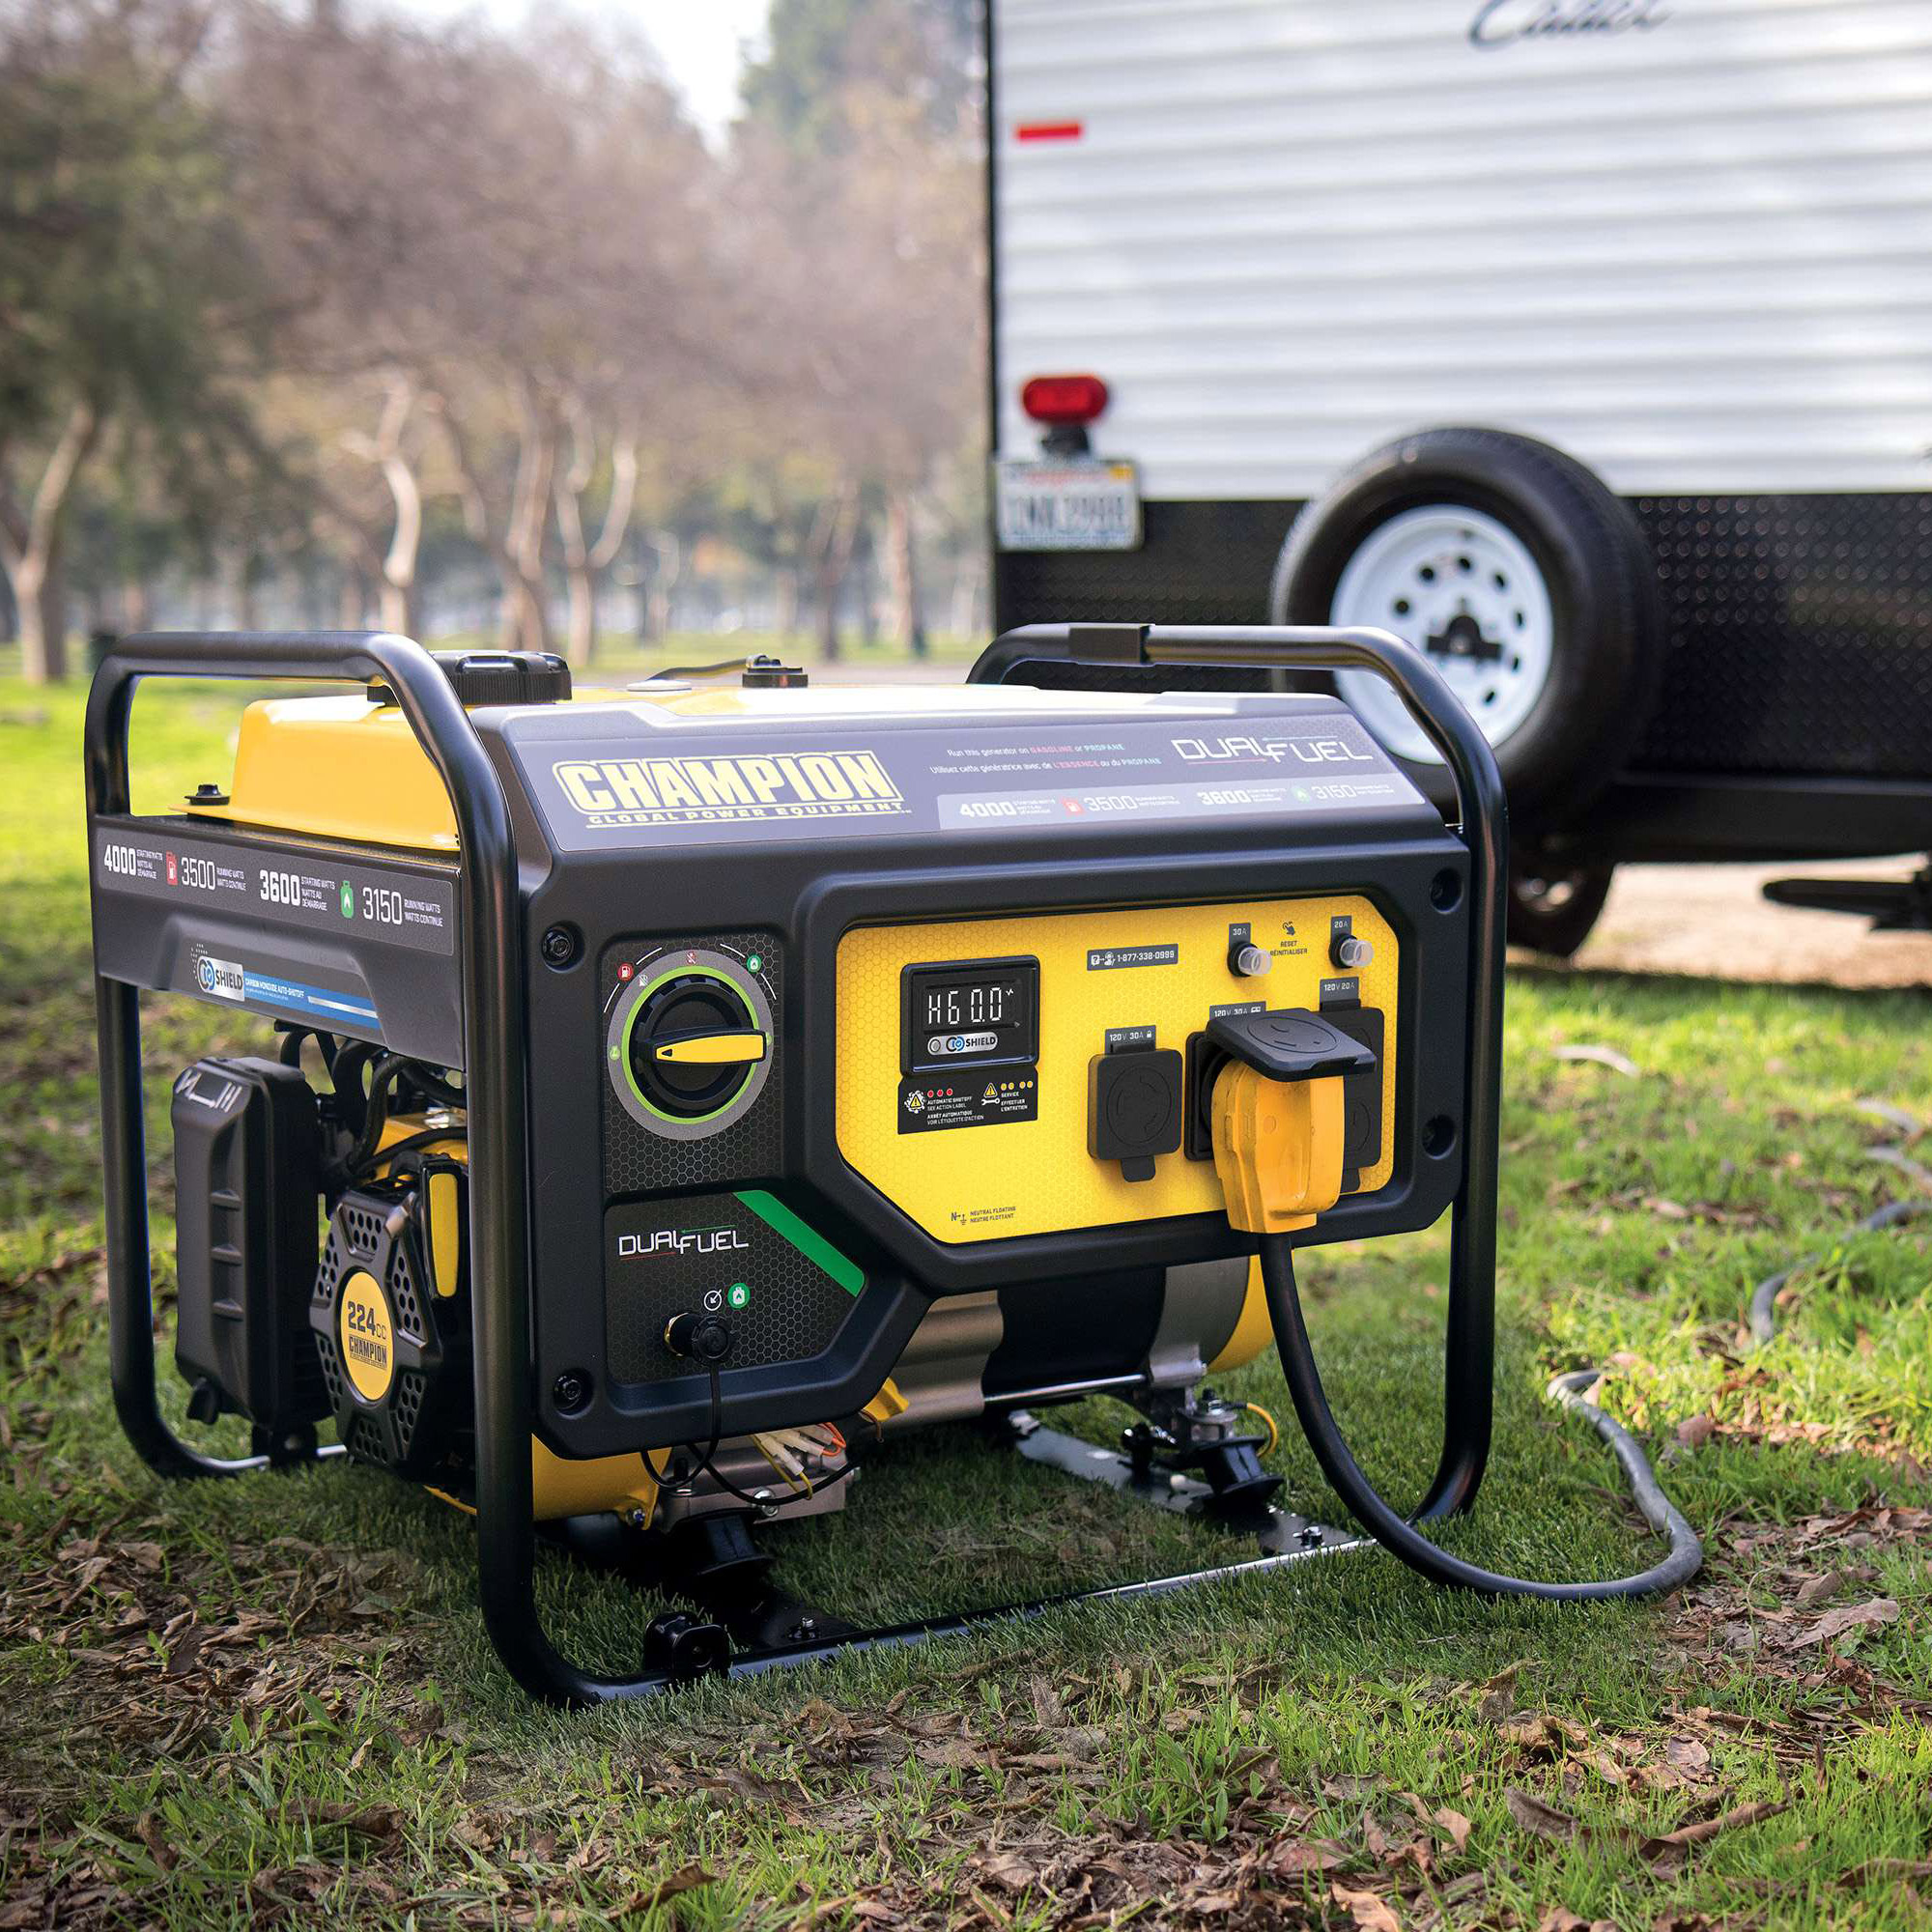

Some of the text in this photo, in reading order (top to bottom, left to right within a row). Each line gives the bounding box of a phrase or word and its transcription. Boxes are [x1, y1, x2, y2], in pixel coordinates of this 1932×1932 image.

[947, 749, 964, 757] Run
[980, 748, 1016, 757] generator
[1122, 756, 1162, 766] PROPANE
[554, 751, 900, 814] CHAMPION
[1311, 784, 1357, 800] 3150
[959, 801, 1018, 818] 4000
[1084, 794, 1139, 812] 3500
[589, 803, 903, 826] GLOBAL POWER EQUIPMENT
[103, 844, 137, 876] 4000
[181, 857, 216, 891] 3500
[260, 868, 301, 907] 3600
[301, 875, 336, 891] STARTING WATTS
[301, 888, 316, 898] WATTS
[363, 887, 403, 925] 3150
[404, 898, 441, 914] RUNNING WATTS
[405, 911, 420, 923] WATTS
[1334, 920, 1350, 928] 20A
[215, 969, 243, 991] SHIELD
[966, 1037, 996, 1048] SHIELD
[927, 1095, 973, 1106] AUTOMATIC SHUTOFF
[942, 1110, 973, 1119] AUTOMATIQUE
[970, 1206, 1016, 1217] NEUTRAL FLOATING
[970, 1215, 989, 1224] NEUTRE
[349, 1336, 387, 1364] CHAMPION
